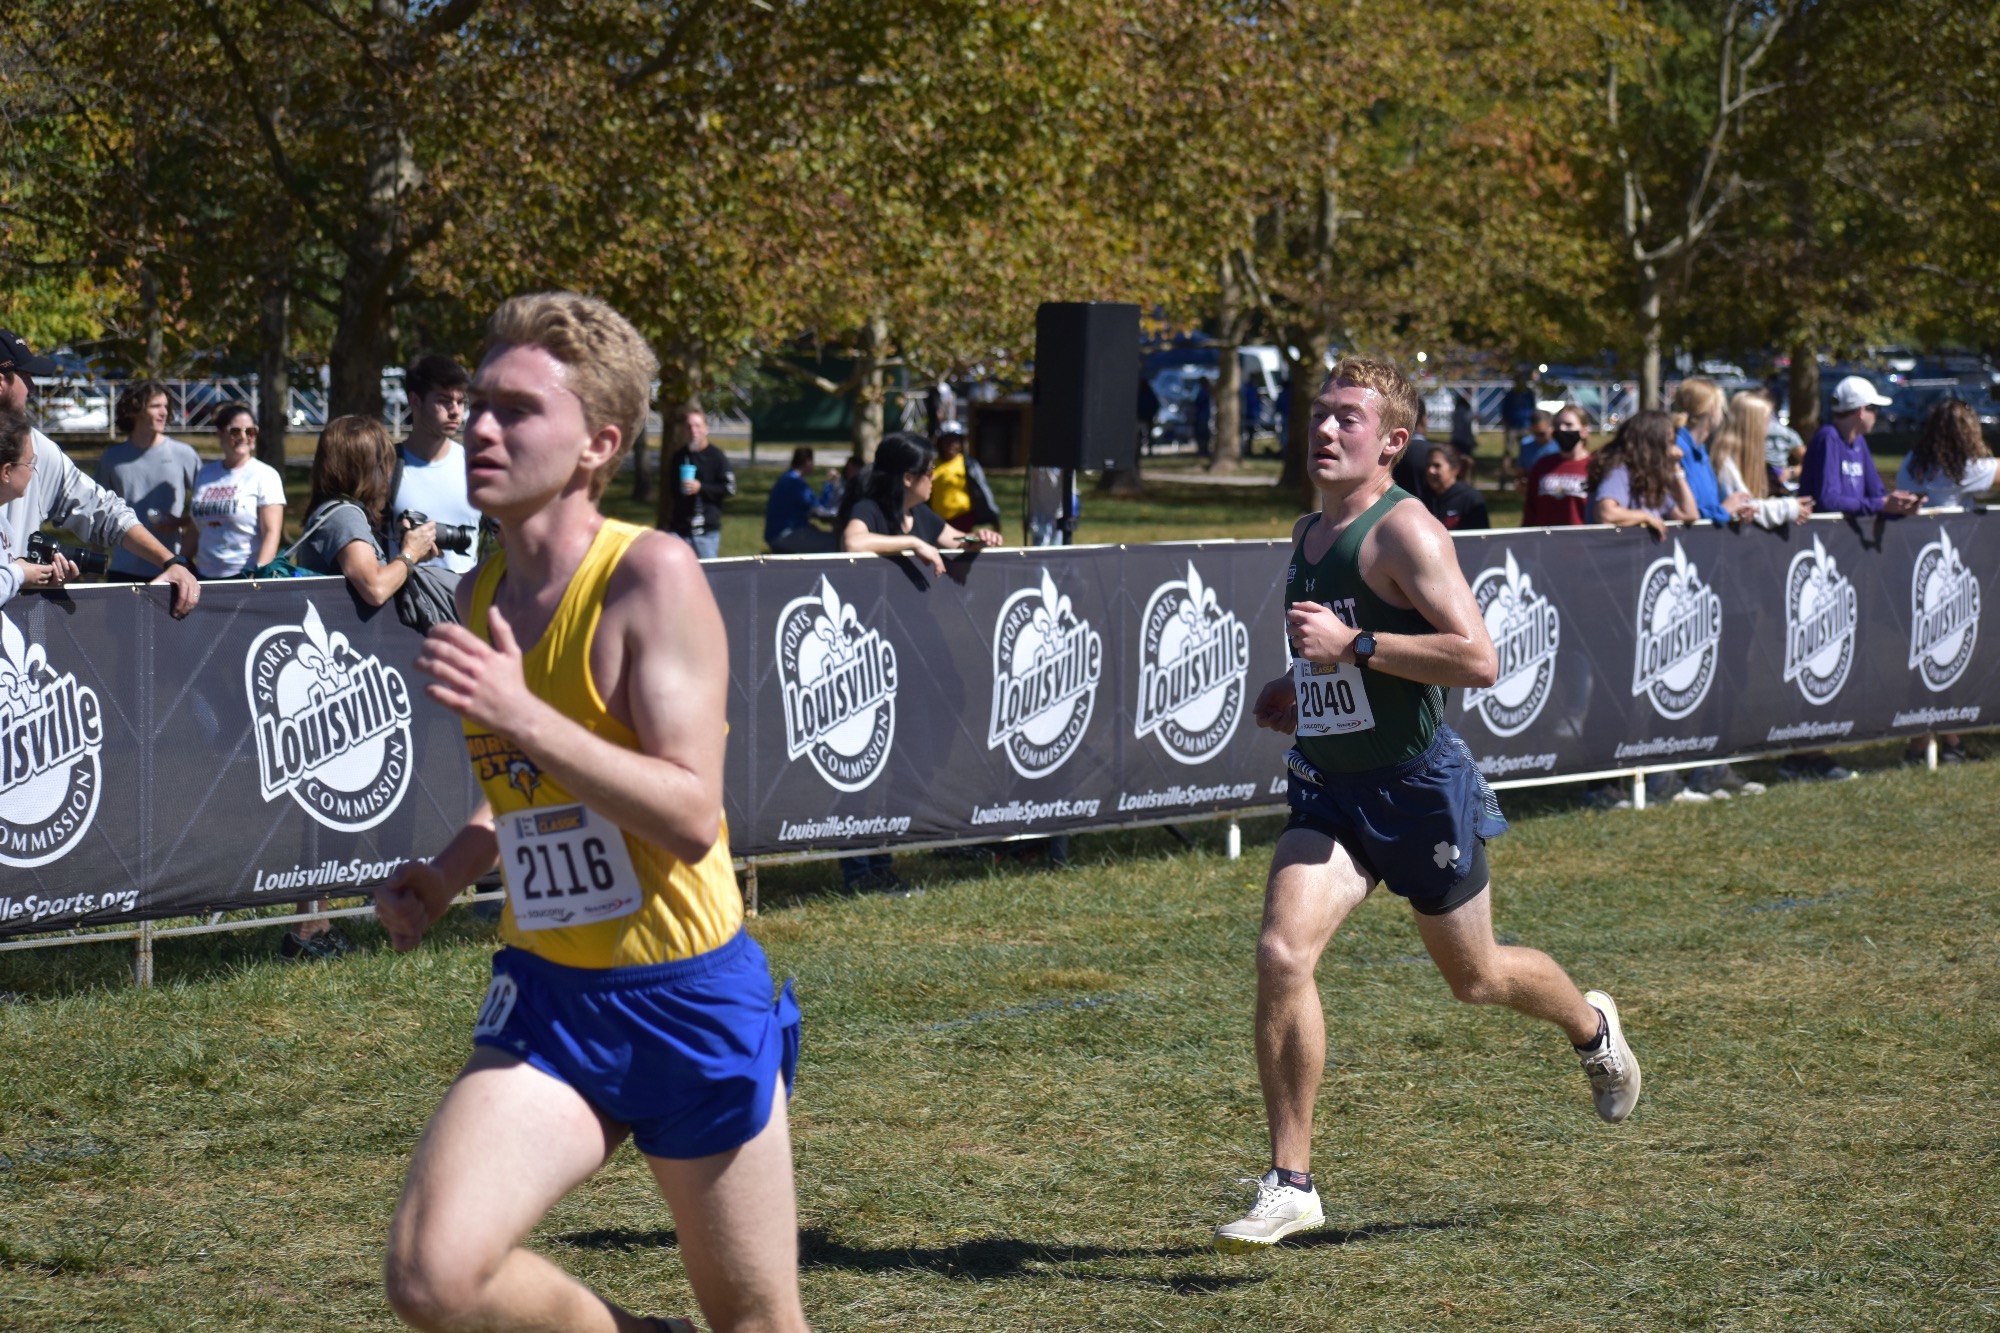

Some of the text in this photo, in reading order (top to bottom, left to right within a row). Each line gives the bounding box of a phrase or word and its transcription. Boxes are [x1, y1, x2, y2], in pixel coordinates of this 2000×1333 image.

[193, 499, 239, 517] COUNTRY
[1147, 594, 1178, 654] SPORTS
[1477, 579, 1498, 614] ORTS
[1643, 569, 1667, 623] SPORTS
[1787, 578, 1857, 674] Louisville
[1911, 569, 1980, 661] Louisville
[785, 609, 812, 672] SPORTS
[1001, 602, 1031, 663] SPORTS
[1466, 598, 1559, 703] isville
[1636, 586, 1721, 686] Louisville
[258, 638, 292, 703] SPORTS
[786, 631, 896, 751] Louisville
[993, 622, 1101, 740] Louisville
[1138, 613, 1248, 729] Louisville
[1301, 680, 1356, 718] 2040
[1311, 665, 1336, 675] CLASSIC
[1486, 667, 1548, 725] COMMISSION
[1655, 653, 1712, 709] COMMISSION
[0, 676, 101, 790] isville
[259, 658, 409, 790] Louisville
[818, 711, 889, 779] COMMISSION
[1013, 700, 1087, 766] COMMISSION
[1165, 688, 1239, 752] COMMISSION
[1614, 735, 1719, 759] LouisvilleSports.org
[1767, 720, 1854, 741] LouisvilleSports.org
[0, 768, 92, 852] OMMISSION
[306, 740, 404, 818] COMMISSION
[1118, 784, 1256, 811] LouisvilleSports.org
[778, 815, 911, 840] LouisvilleSports.org
[971, 799, 1100, 824] LouisvilleSports.org
[516, 837, 615, 900] 2116
[0, 890, 139, 922] lleSports.org
